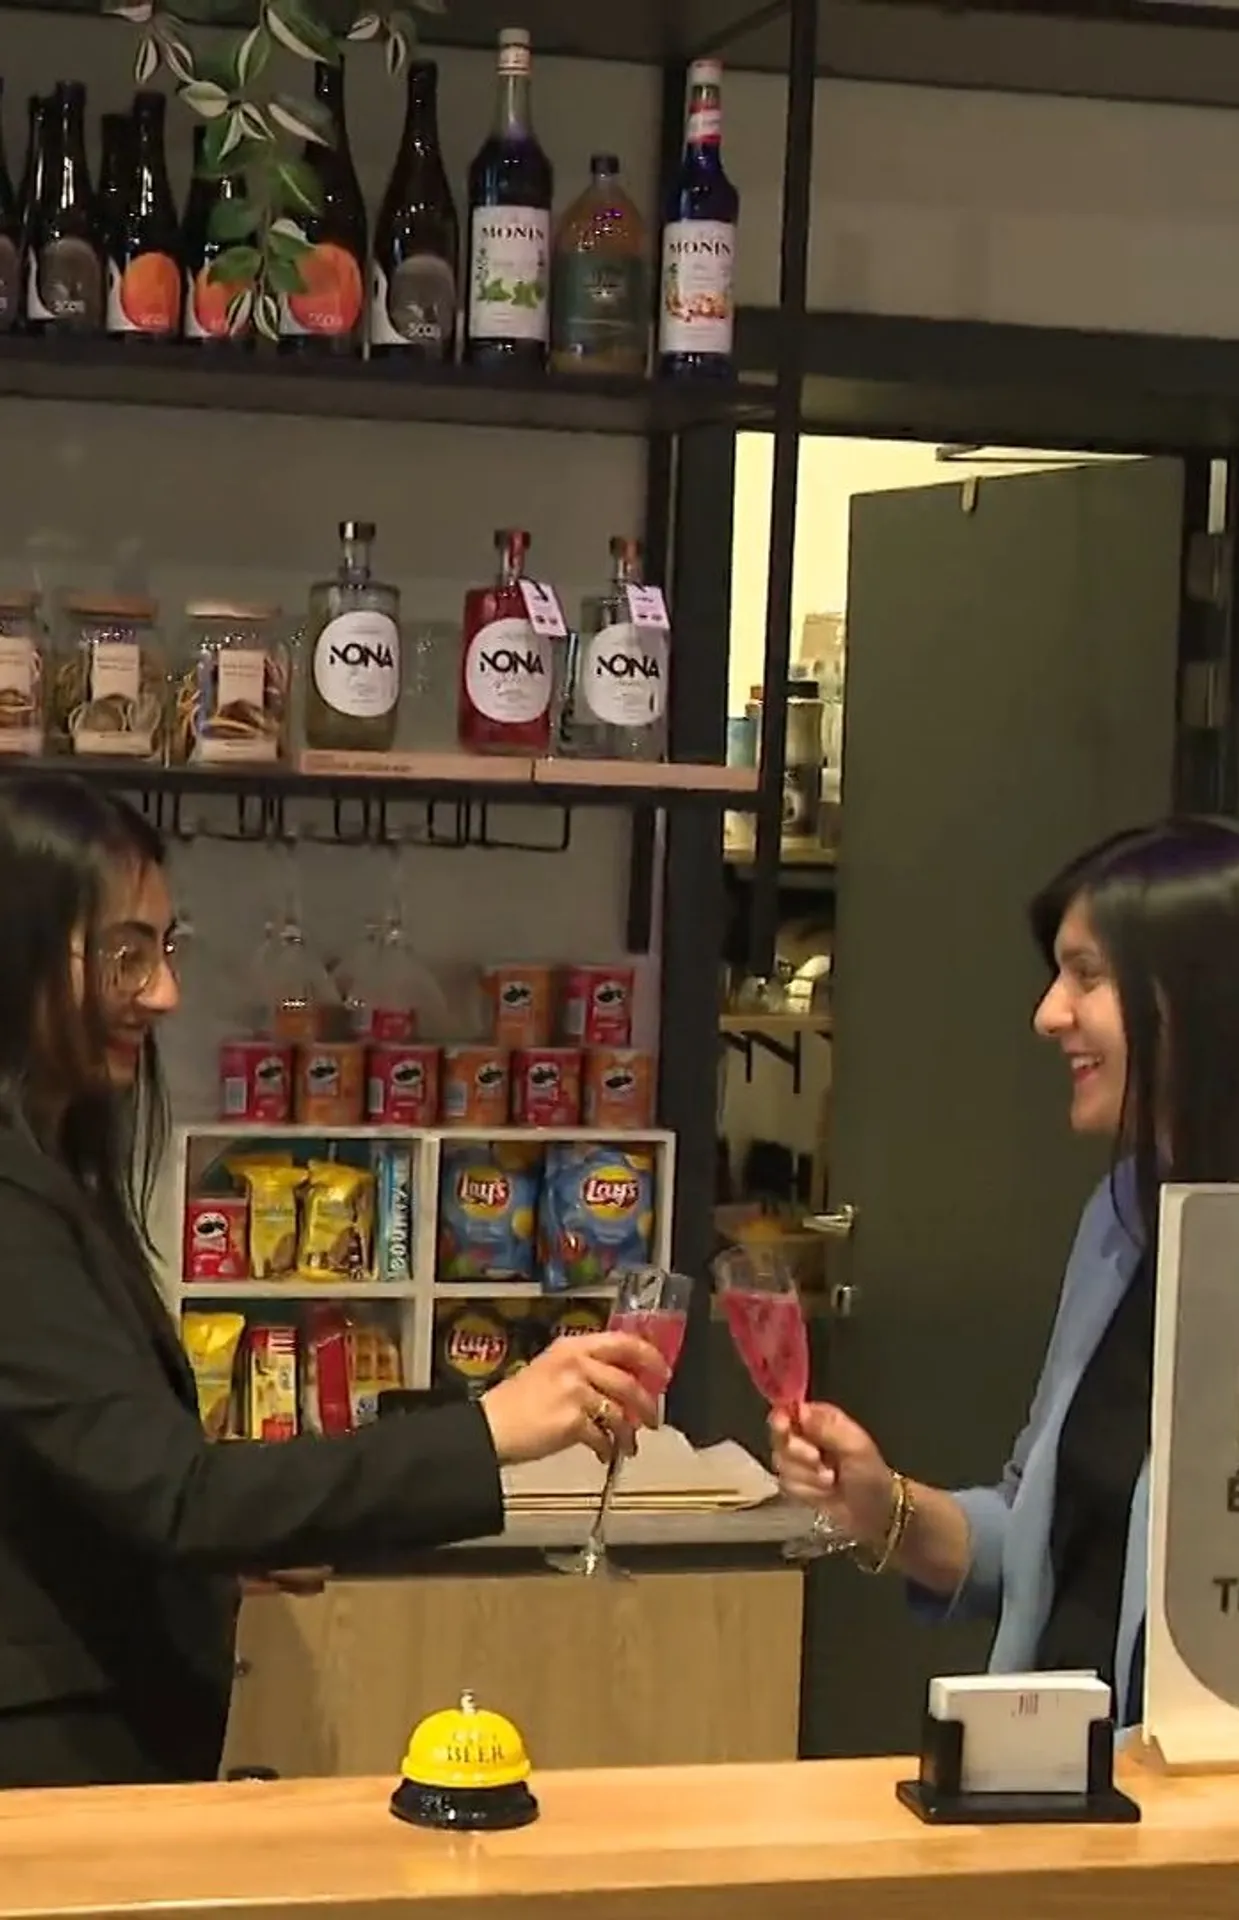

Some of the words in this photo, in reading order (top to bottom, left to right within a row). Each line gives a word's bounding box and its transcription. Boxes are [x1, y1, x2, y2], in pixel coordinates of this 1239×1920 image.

[481, 226, 546, 240] MONIN
[668, 240, 731, 254] MONIN
[329, 643, 394, 668] NONA
[480, 650, 545, 675] NONA
[597, 654, 660, 679] NONA
